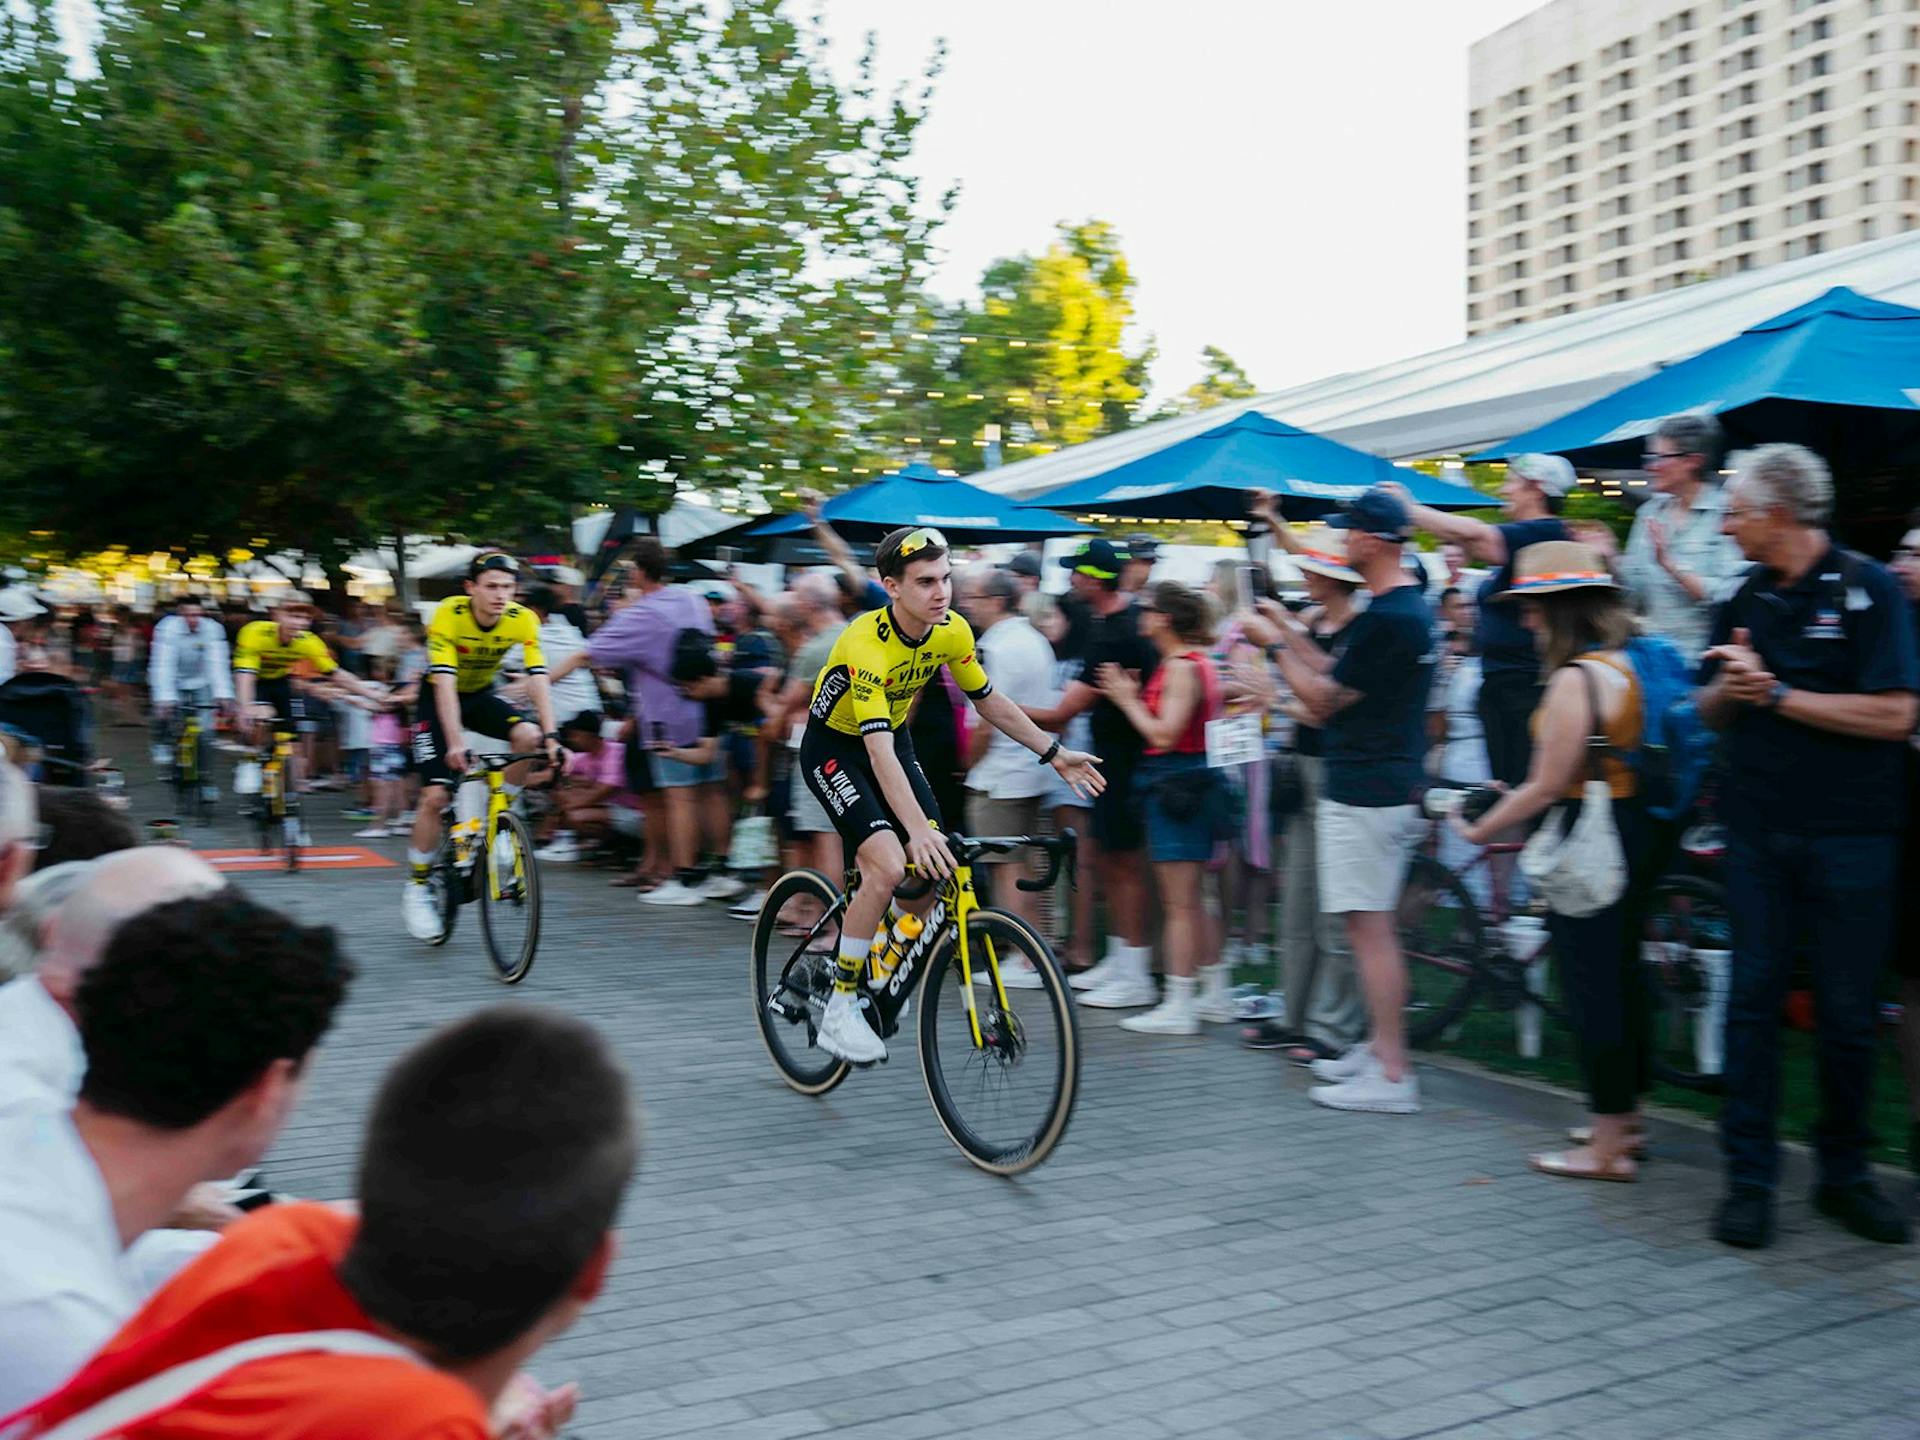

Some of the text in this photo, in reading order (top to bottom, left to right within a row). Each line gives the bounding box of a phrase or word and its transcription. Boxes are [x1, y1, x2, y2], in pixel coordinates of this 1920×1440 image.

[858, 668, 884, 687] VISM
[899, 664, 934, 683] VISM
[830, 769, 861, 807] VISMA
